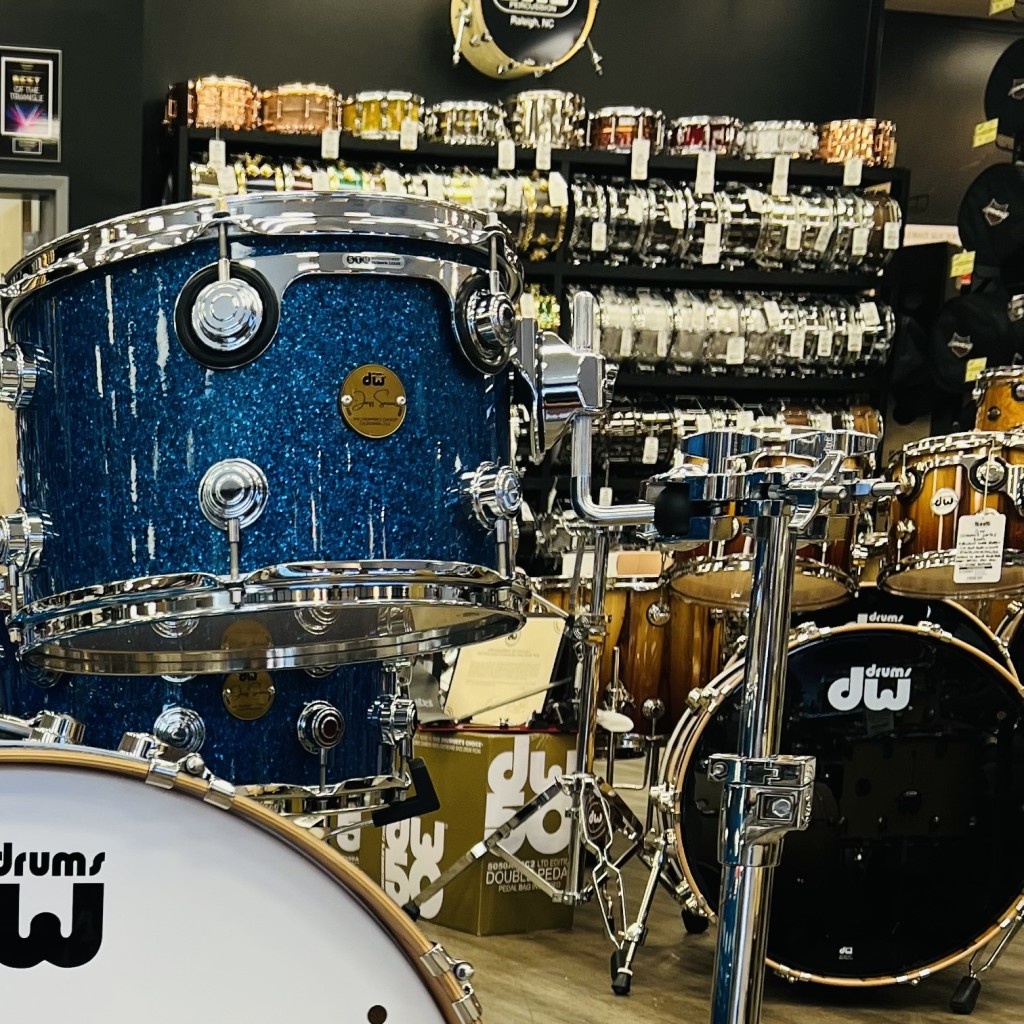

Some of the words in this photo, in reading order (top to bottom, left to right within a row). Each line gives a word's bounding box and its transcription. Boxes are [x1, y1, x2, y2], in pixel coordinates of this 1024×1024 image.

[541, 18, 555, 29] NC
[869, 612, 904, 622] drums
[866, 664, 912, 677] drums
[828, 667, 911, 711] dw
[588, 810, 602, 824] dw
[537, 867, 568, 881] PEDA
